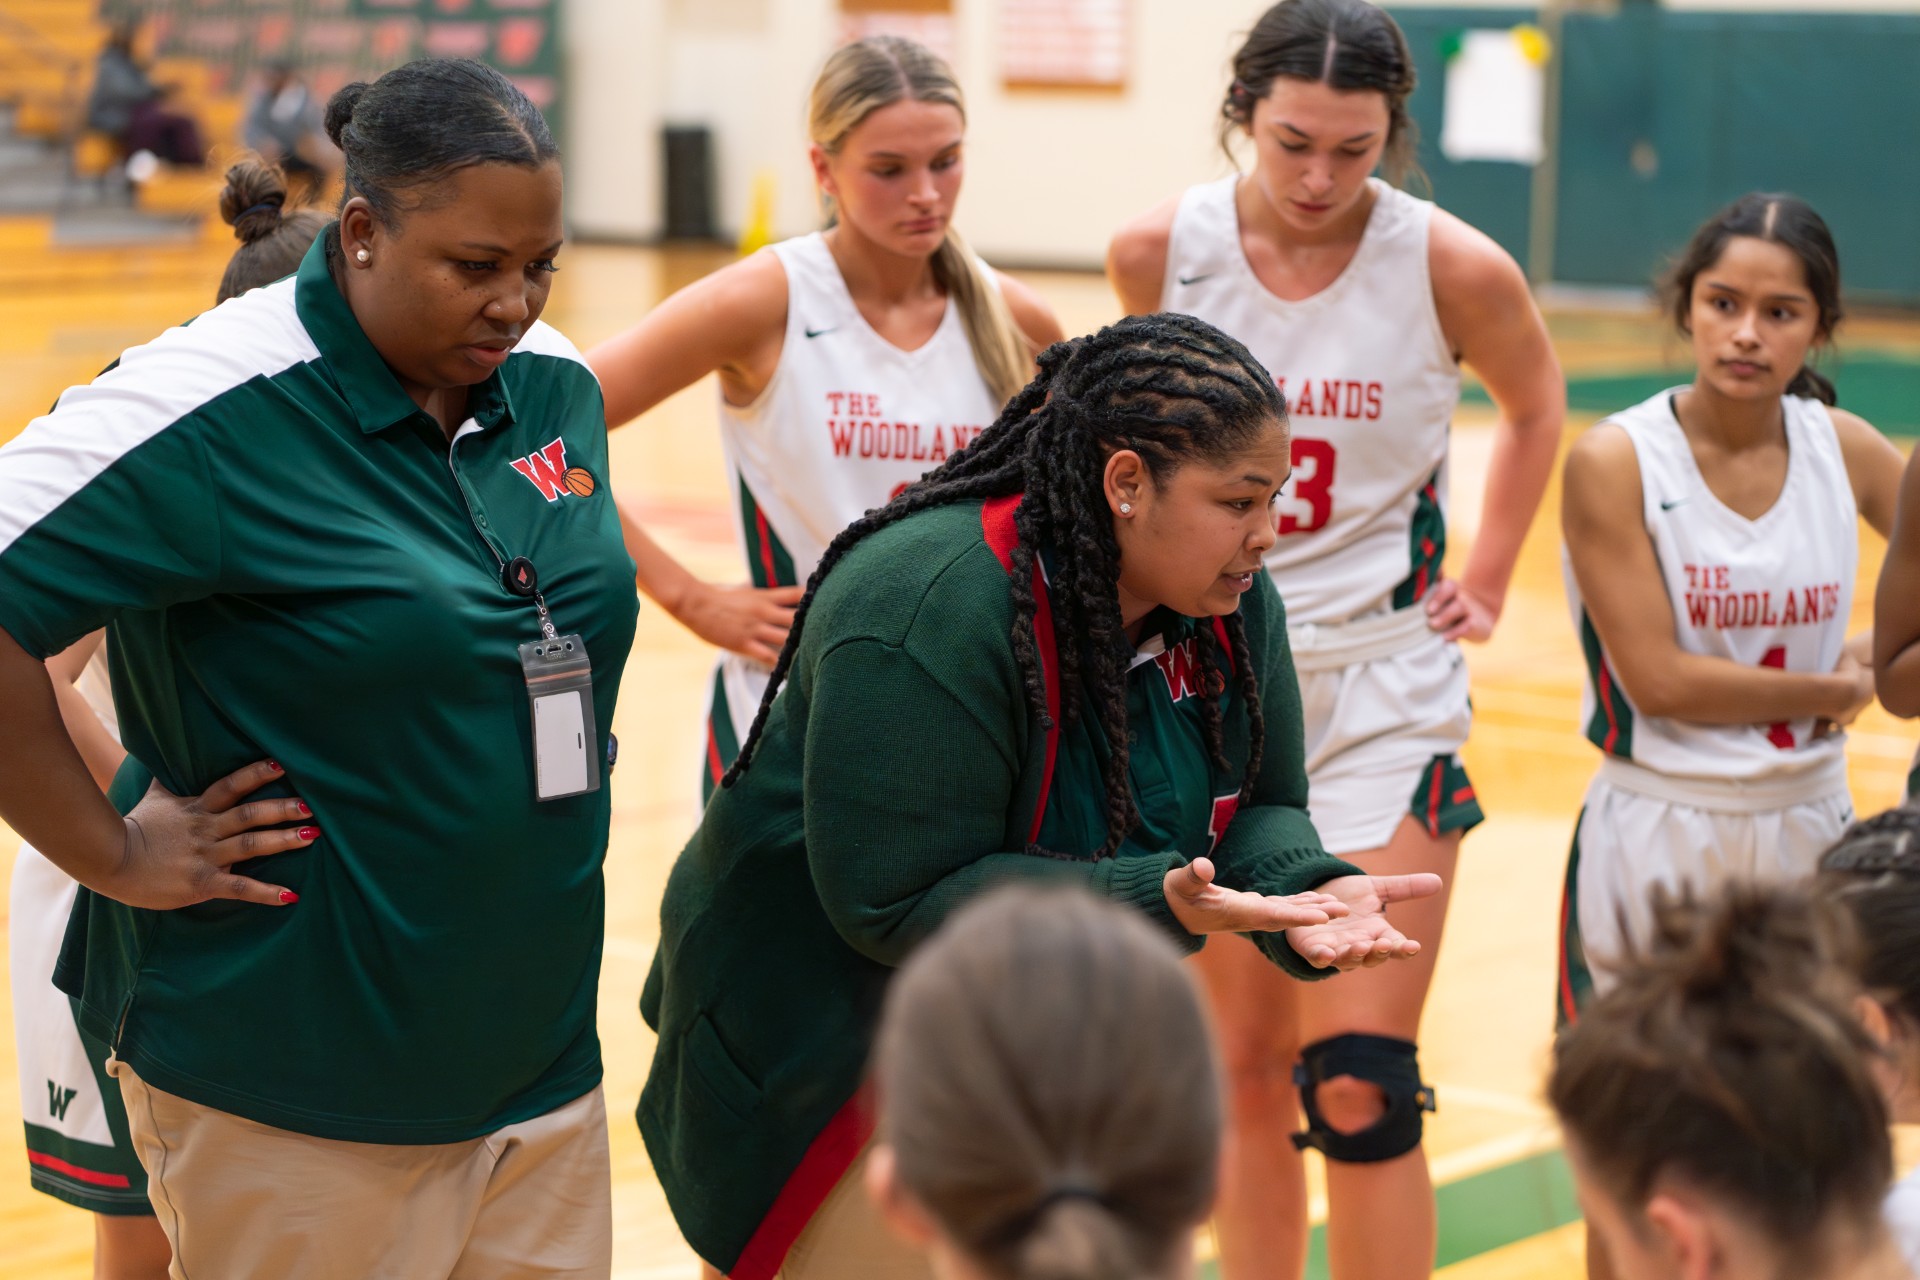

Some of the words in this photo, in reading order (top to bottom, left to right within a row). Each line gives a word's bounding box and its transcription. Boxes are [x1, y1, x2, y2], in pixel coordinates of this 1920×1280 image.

[826, 391, 882, 417] THE
[827, 419, 984, 462] WOODLAN
[509, 436, 573, 502] W
[47, 1079, 78, 1122] W
